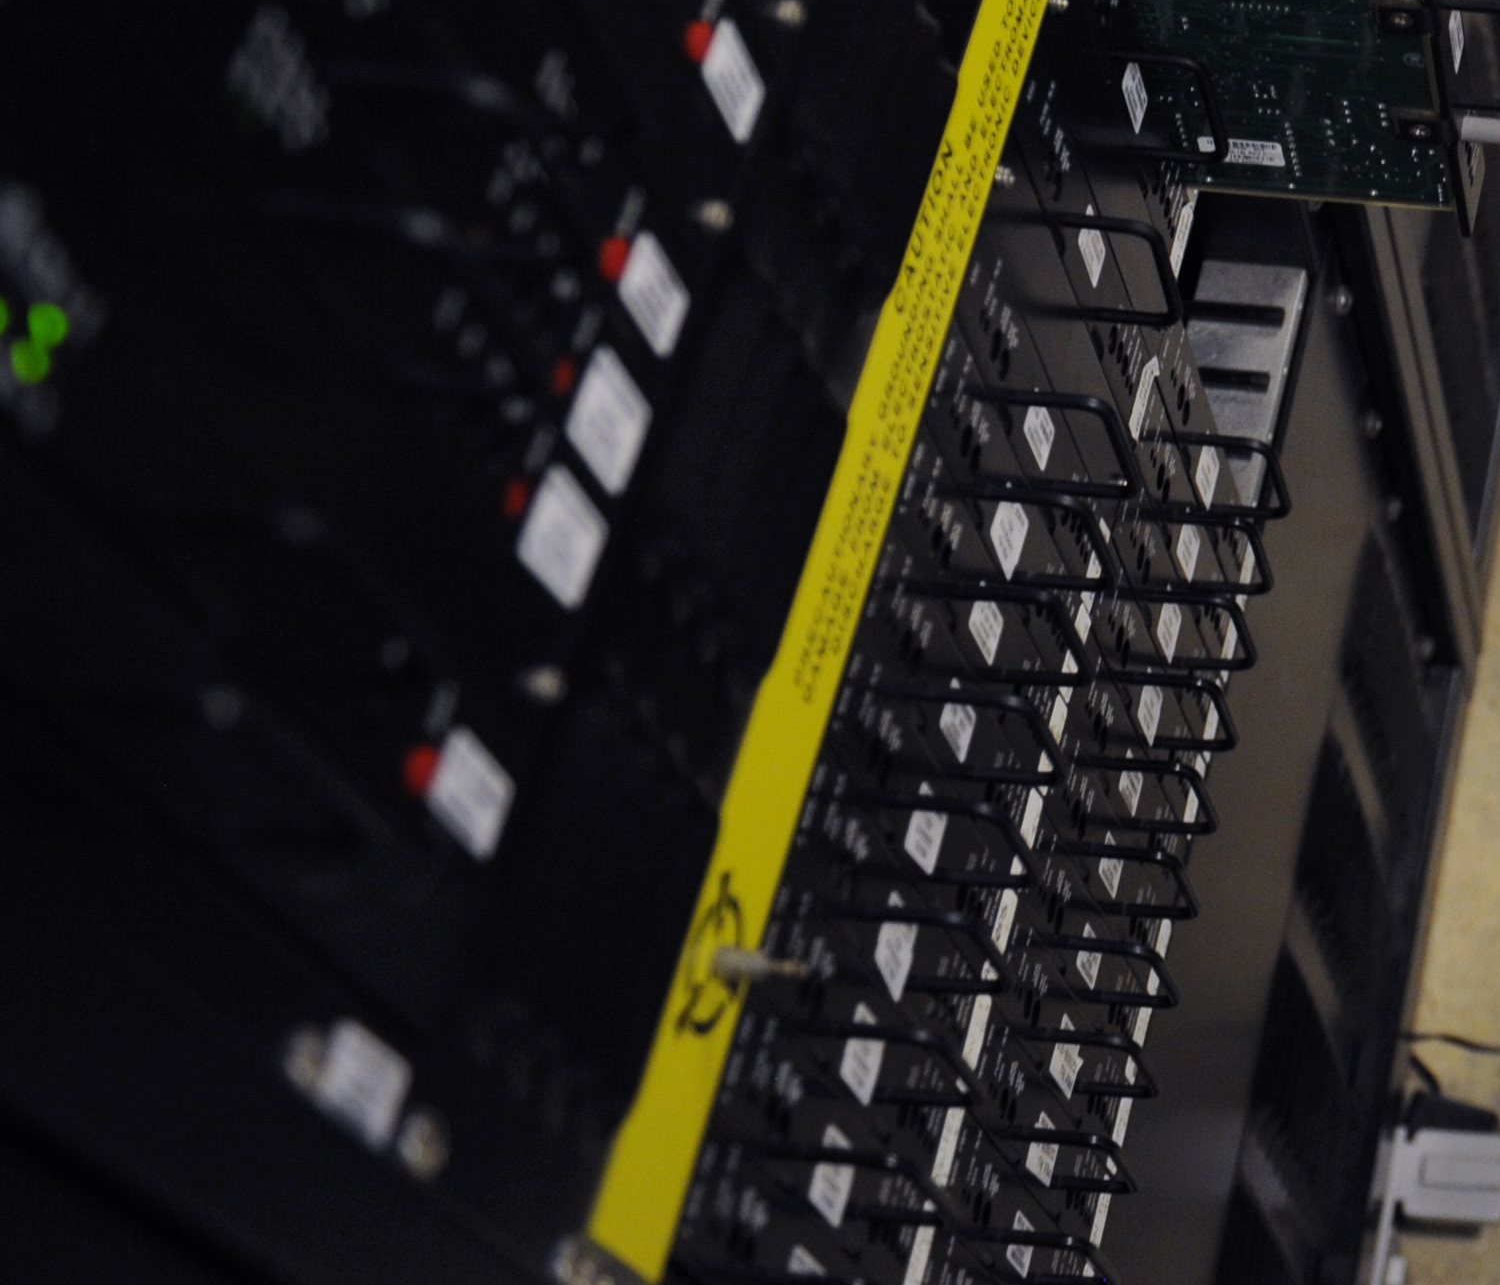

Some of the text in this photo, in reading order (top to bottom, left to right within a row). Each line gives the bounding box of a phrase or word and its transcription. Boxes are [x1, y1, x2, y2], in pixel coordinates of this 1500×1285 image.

[792, 432, 876, 690] PRECAUTIONARY
[877, 251, 933, 423] GROUNDING
[934, 157, 963, 245] SHALL
[963, 113, 977, 152] BE
[976, 37, 1001, 109] USED
[801, 568, 847, 707] DAMAGE
[849, 466, 879, 555] FROM
[880, 220, 956, 454] ELECTROSTATIC
[958, 150, 978, 209] AND
[830, 475, 890, 657] DISCHARGE
[890, 420, 907, 466] TO
[907, 262, 956, 412] SENSITIVE
[956, 82, 1011, 254] ELECTRONIC
[892, 136, 954, 318] CAUTION
